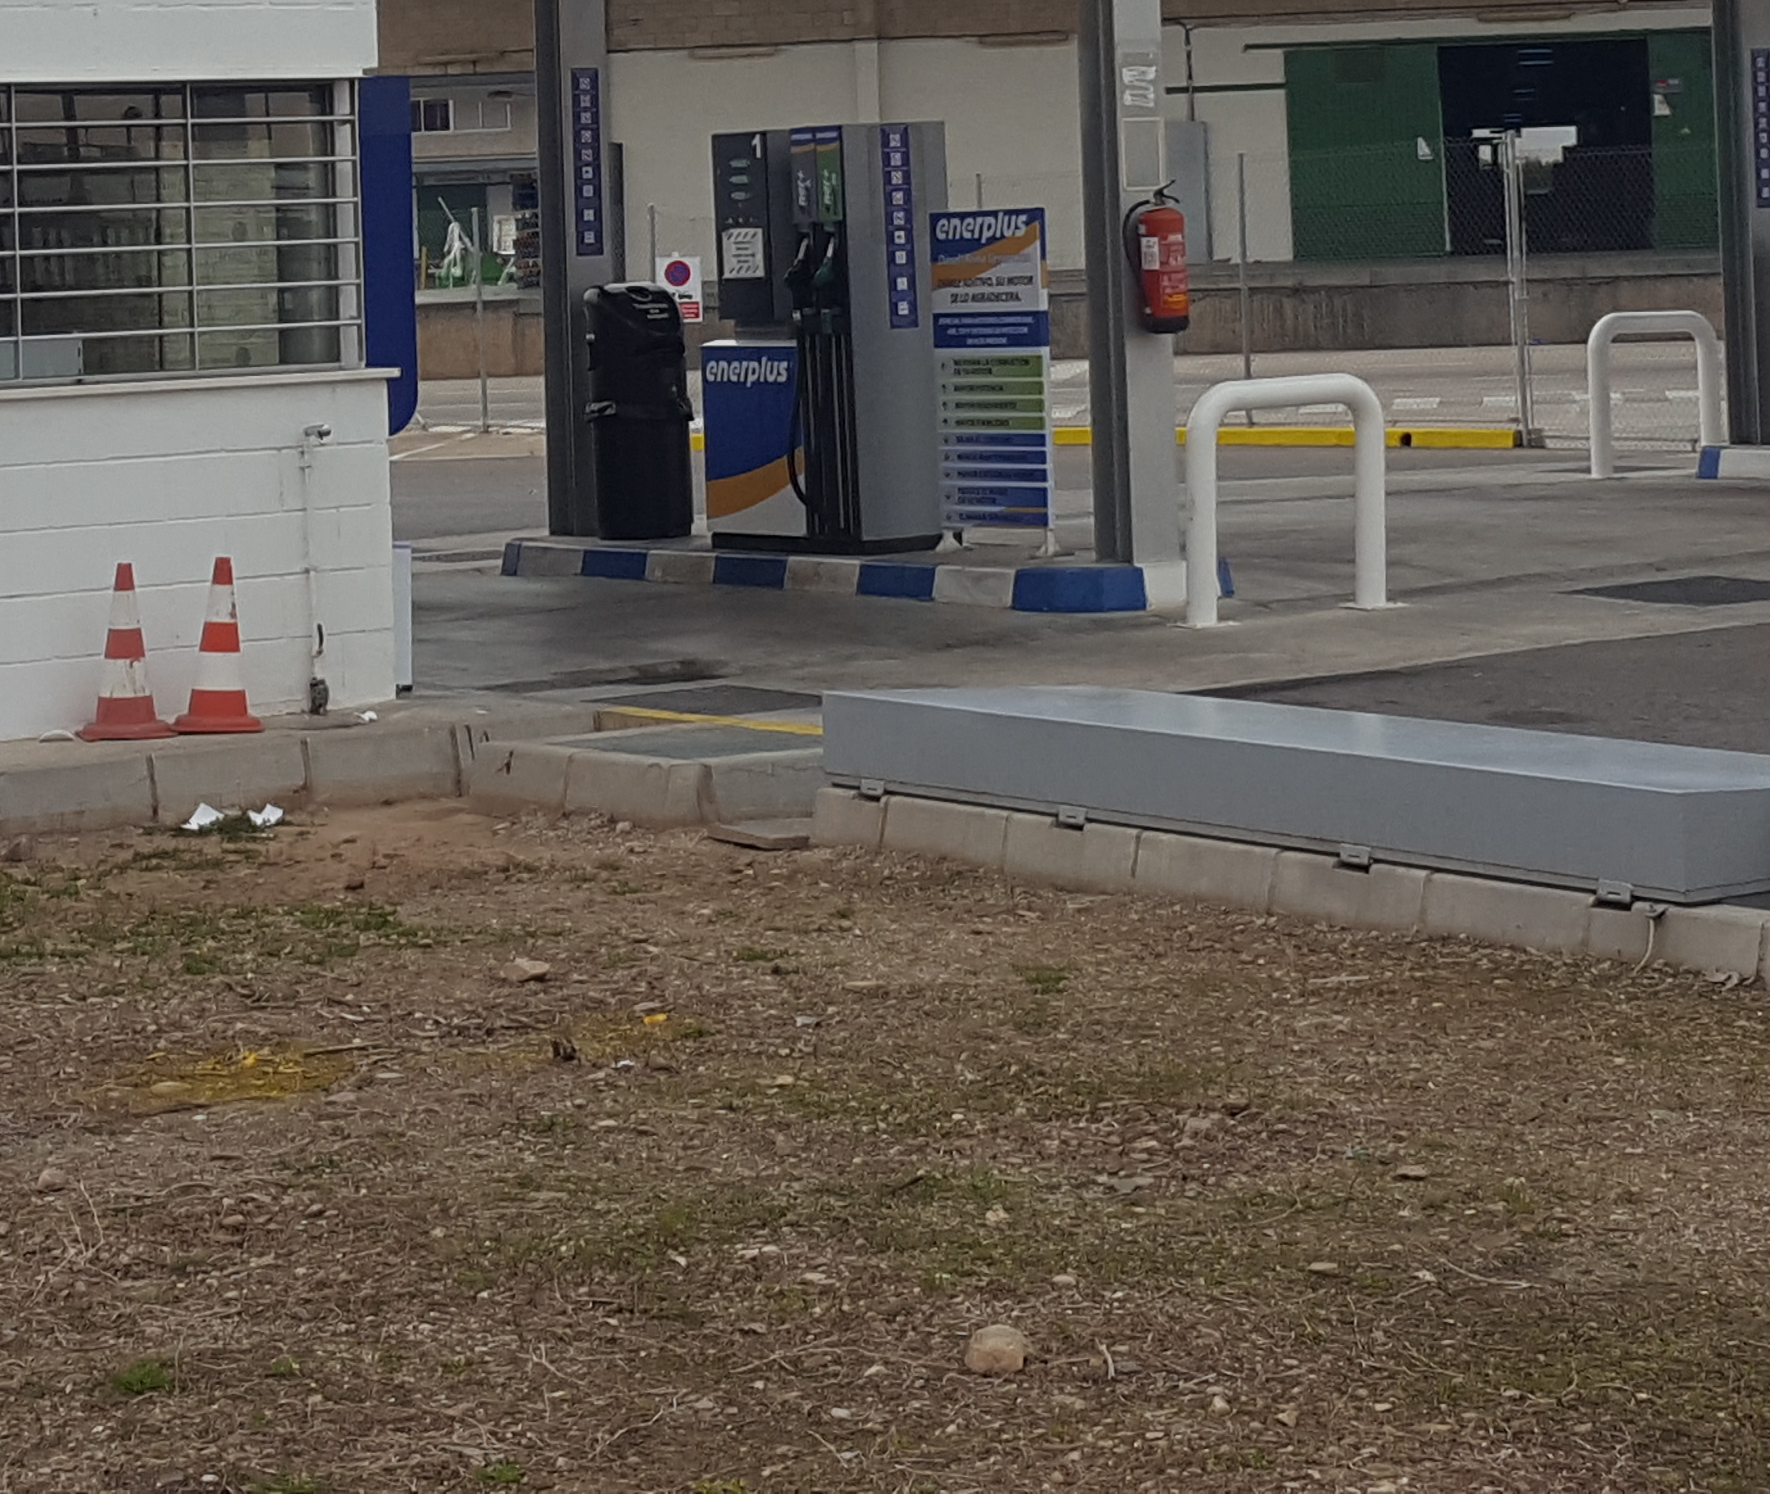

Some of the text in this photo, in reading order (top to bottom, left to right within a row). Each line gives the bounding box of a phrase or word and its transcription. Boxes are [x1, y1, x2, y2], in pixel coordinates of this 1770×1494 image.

[751, 134, 761, 159] 1
[935, 211, 1028, 244] enerplus
[706, 356, 788, 387] enerplus
